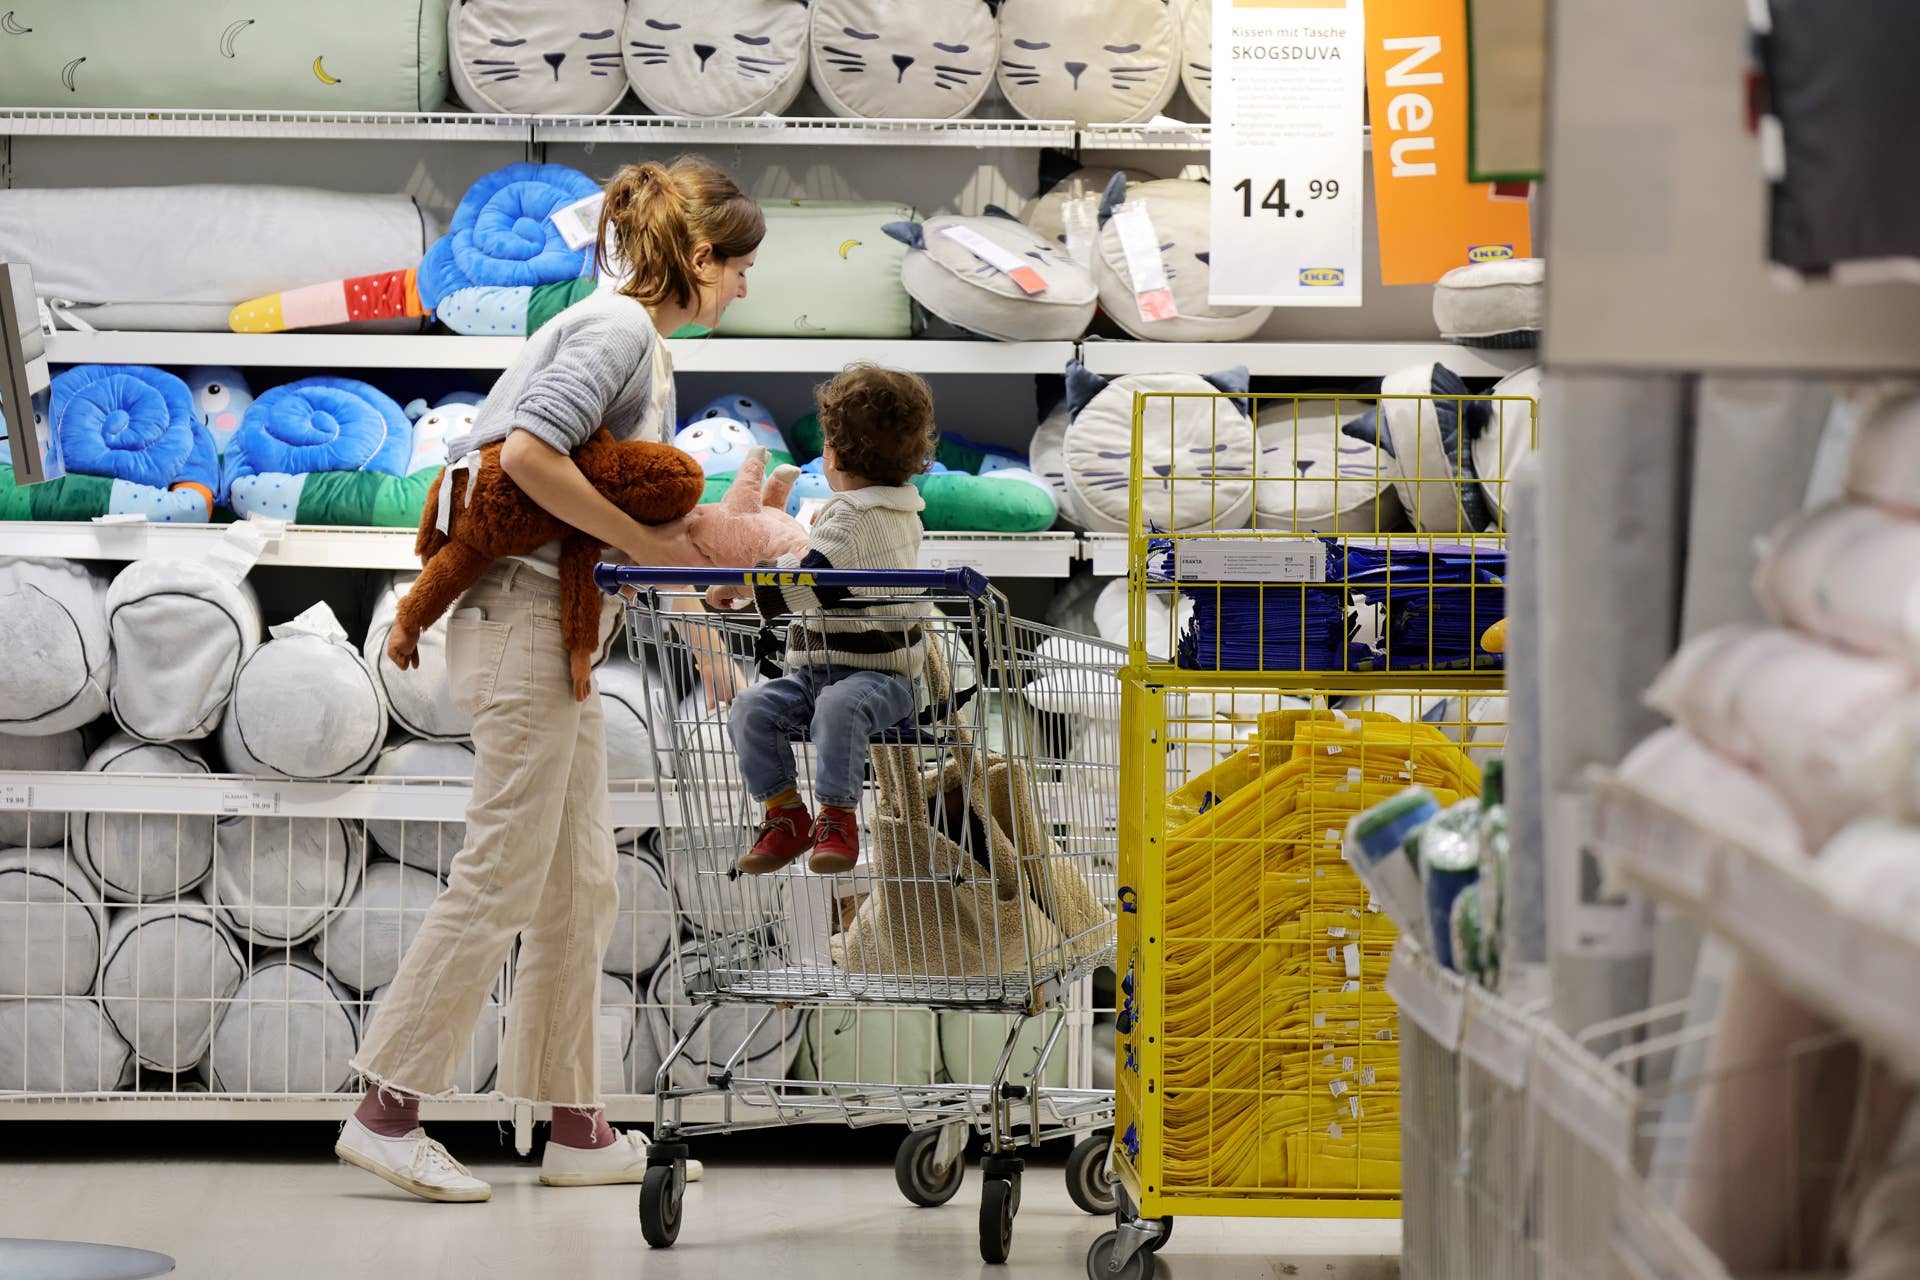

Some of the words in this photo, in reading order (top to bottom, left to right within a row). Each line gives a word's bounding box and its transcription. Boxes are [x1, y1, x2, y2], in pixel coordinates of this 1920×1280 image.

[1231, 27, 1273, 38] Kissen
[1277, 27, 1299, 38] mit
[1303, 27, 1346, 38] Tasche
[1231, 46, 1342, 60] SKOGSDUVA
[1382, 35, 1444, 177] Neu
[1472, 248, 1509, 259] IKEA
[1303, 272, 1341, 282] IKEA
[743, 572, 817, 586] IKEA
